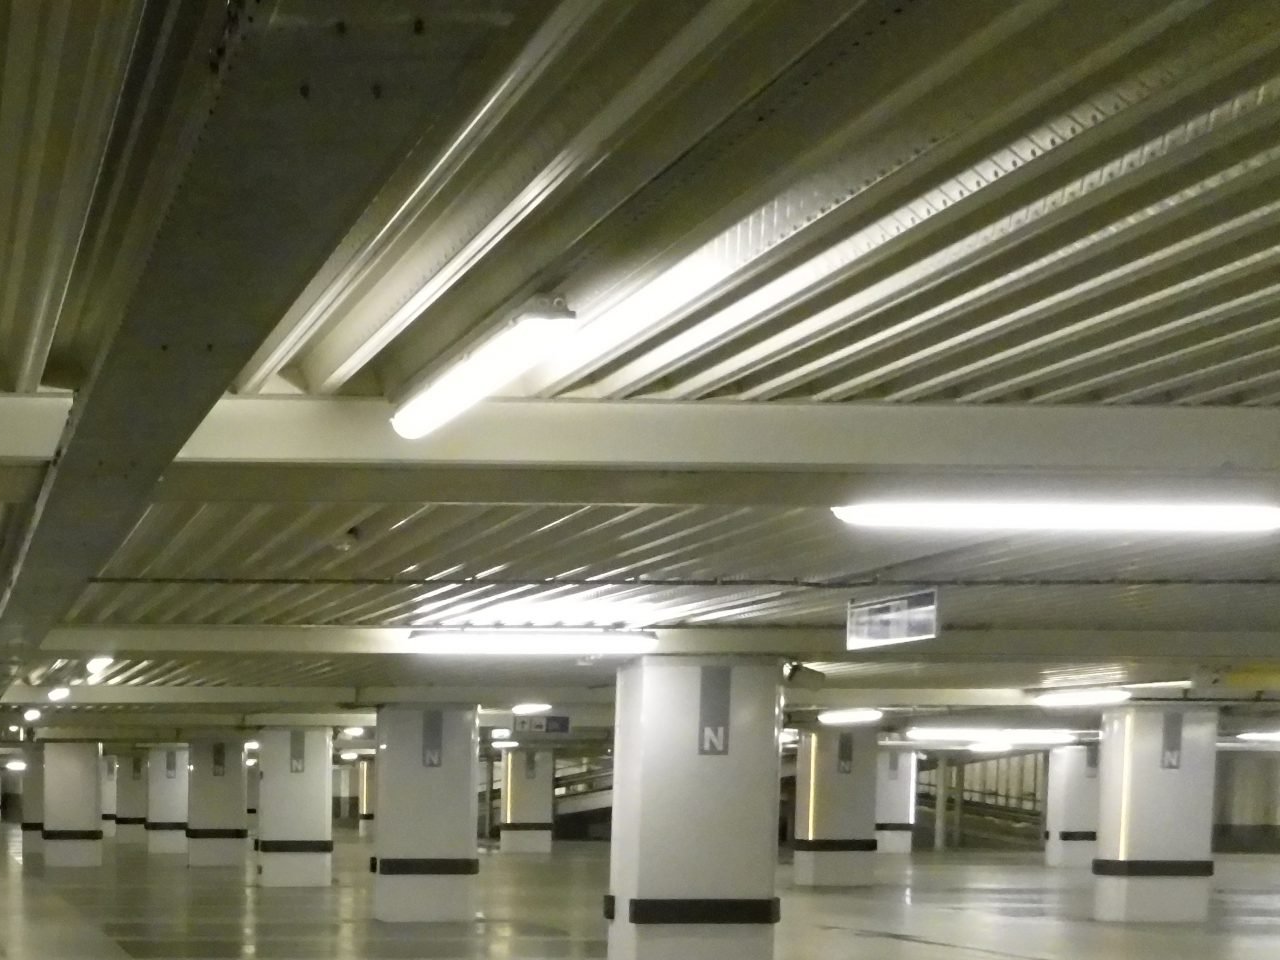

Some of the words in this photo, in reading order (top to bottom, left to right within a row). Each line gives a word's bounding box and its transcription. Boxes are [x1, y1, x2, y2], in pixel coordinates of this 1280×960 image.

[703, 726, 724, 751] N
[291, 759, 303, 771] N
[425, 749, 440, 765] N
[1163, 750, 1179, 767] N
